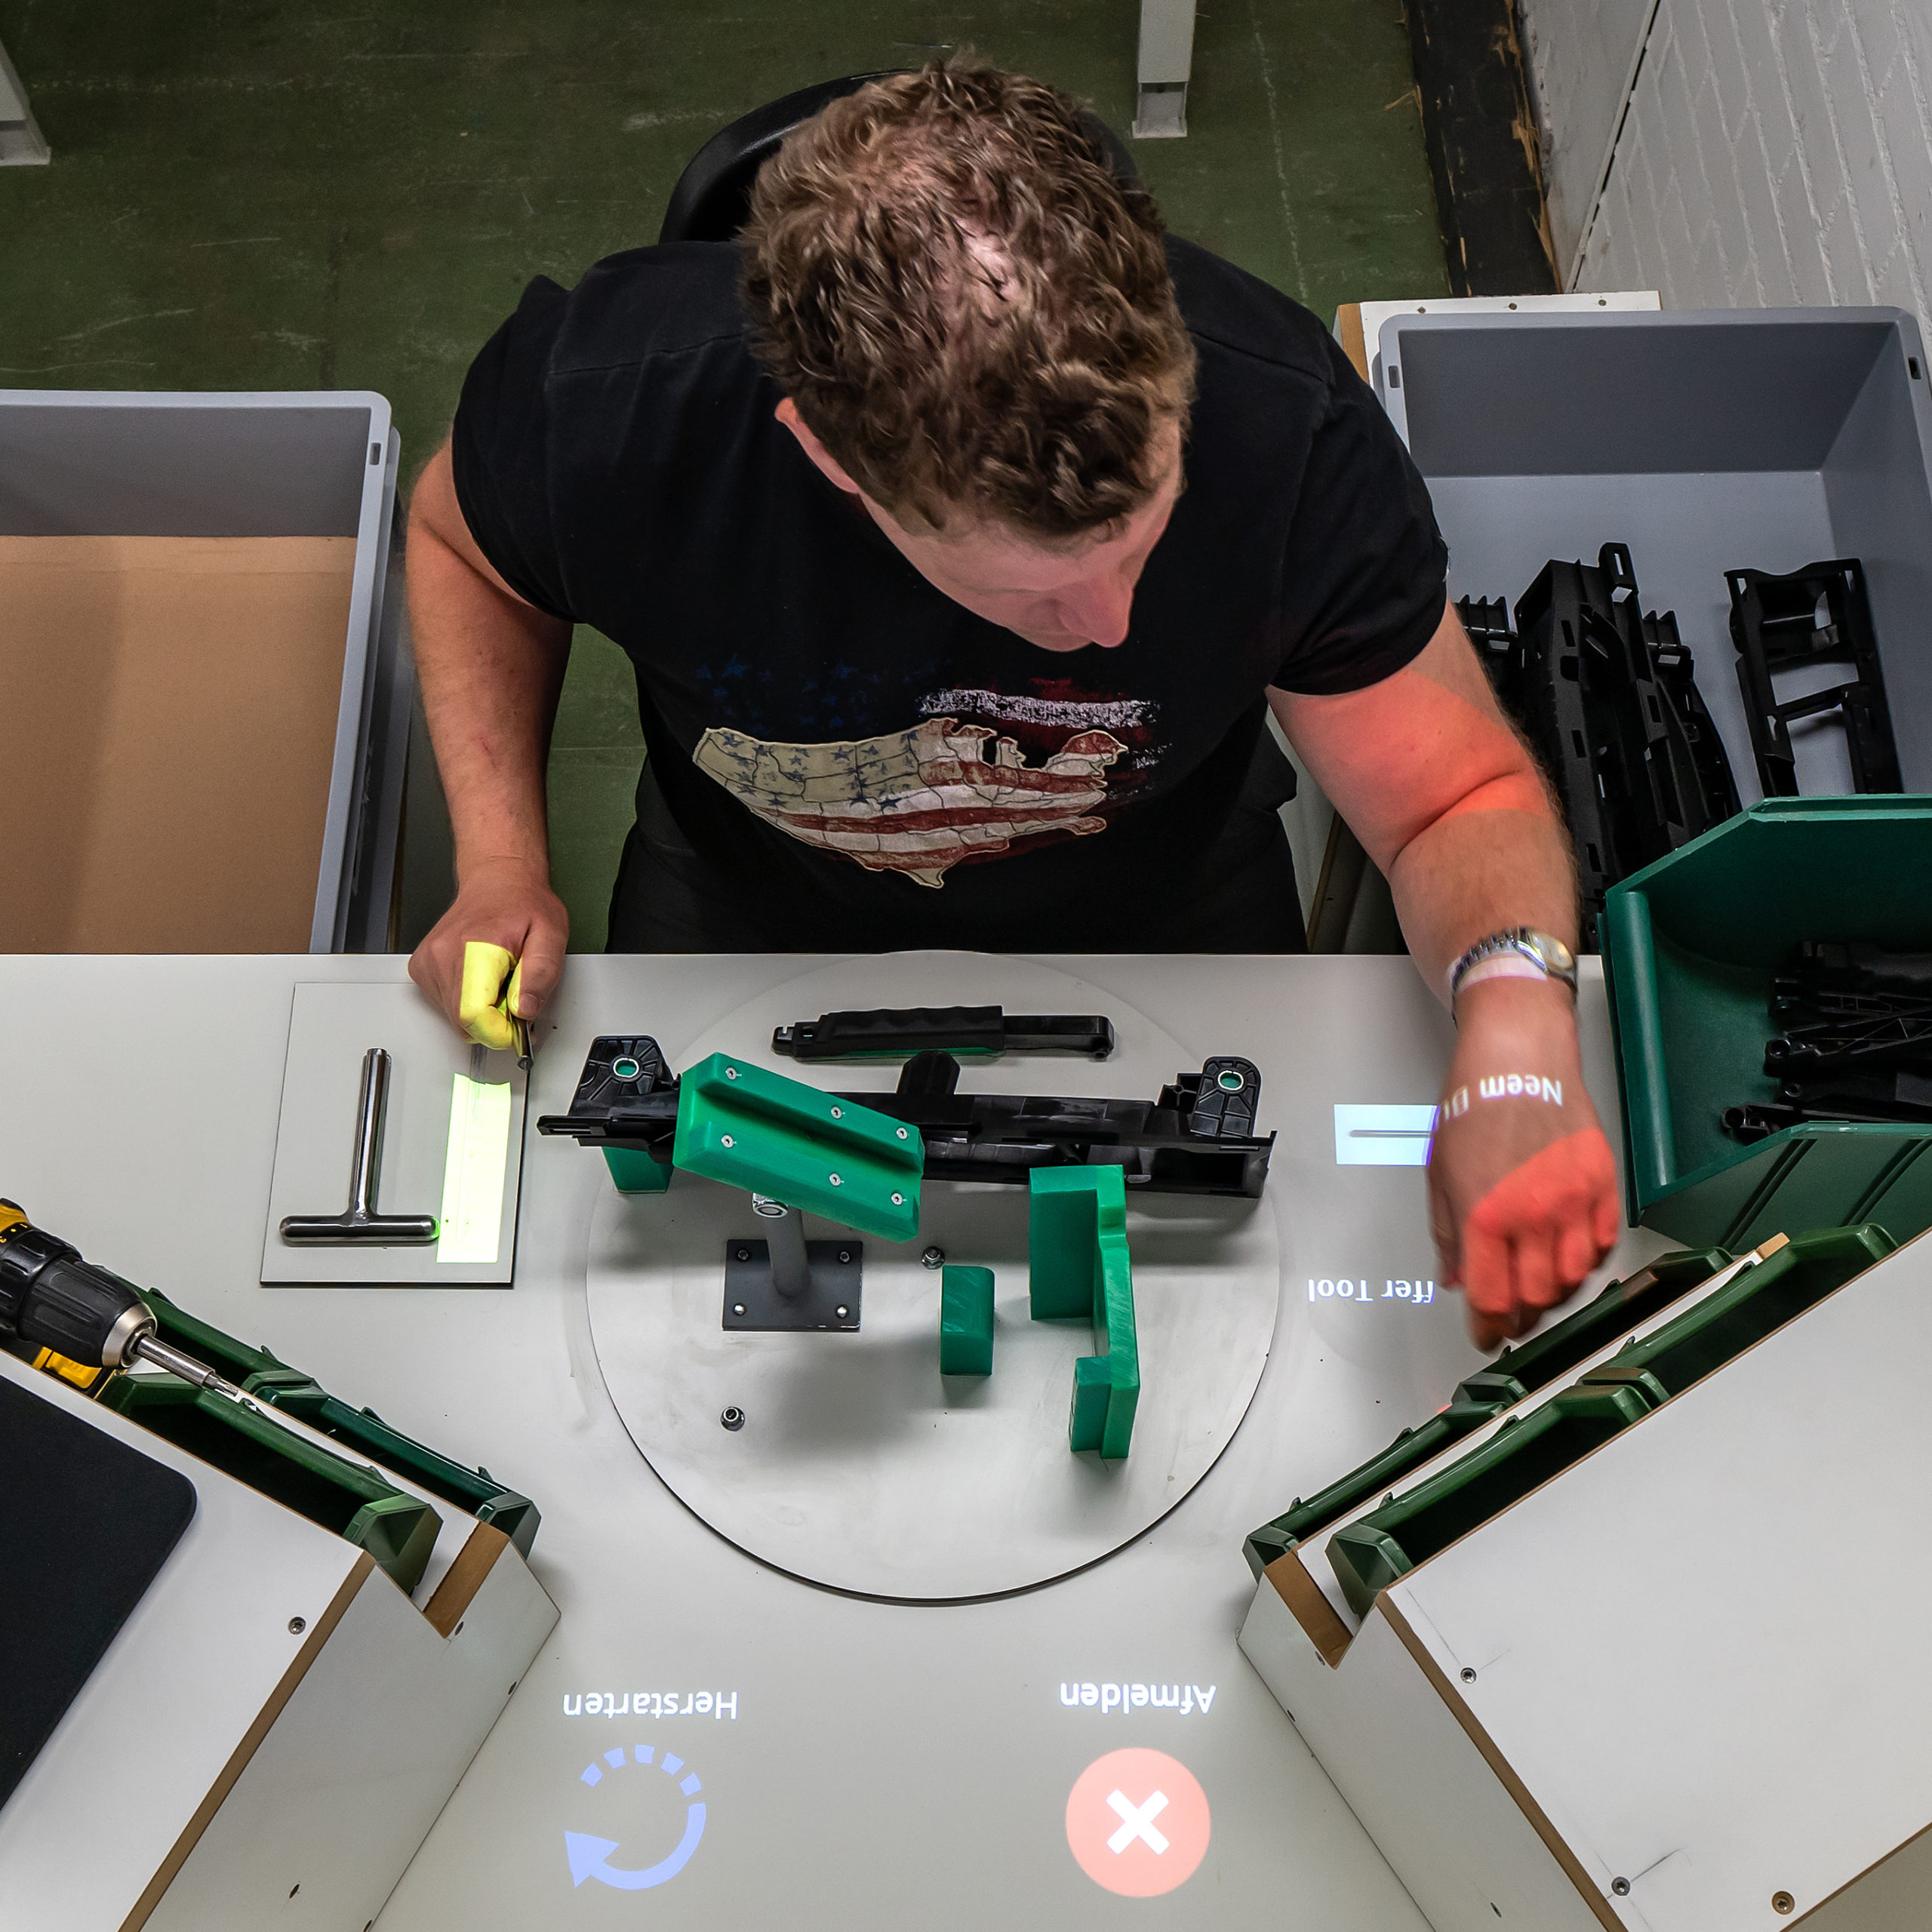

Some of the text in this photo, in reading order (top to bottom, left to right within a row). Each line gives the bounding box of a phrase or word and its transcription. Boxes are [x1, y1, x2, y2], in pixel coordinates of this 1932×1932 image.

[1480, 1073, 1563, 1107] Neem
[1307, 1278, 1435, 1304] ffer Tool
[563, 1691, 737, 1720] Herstarten
[1060, 1682, 1217, 1715] Afmelden
